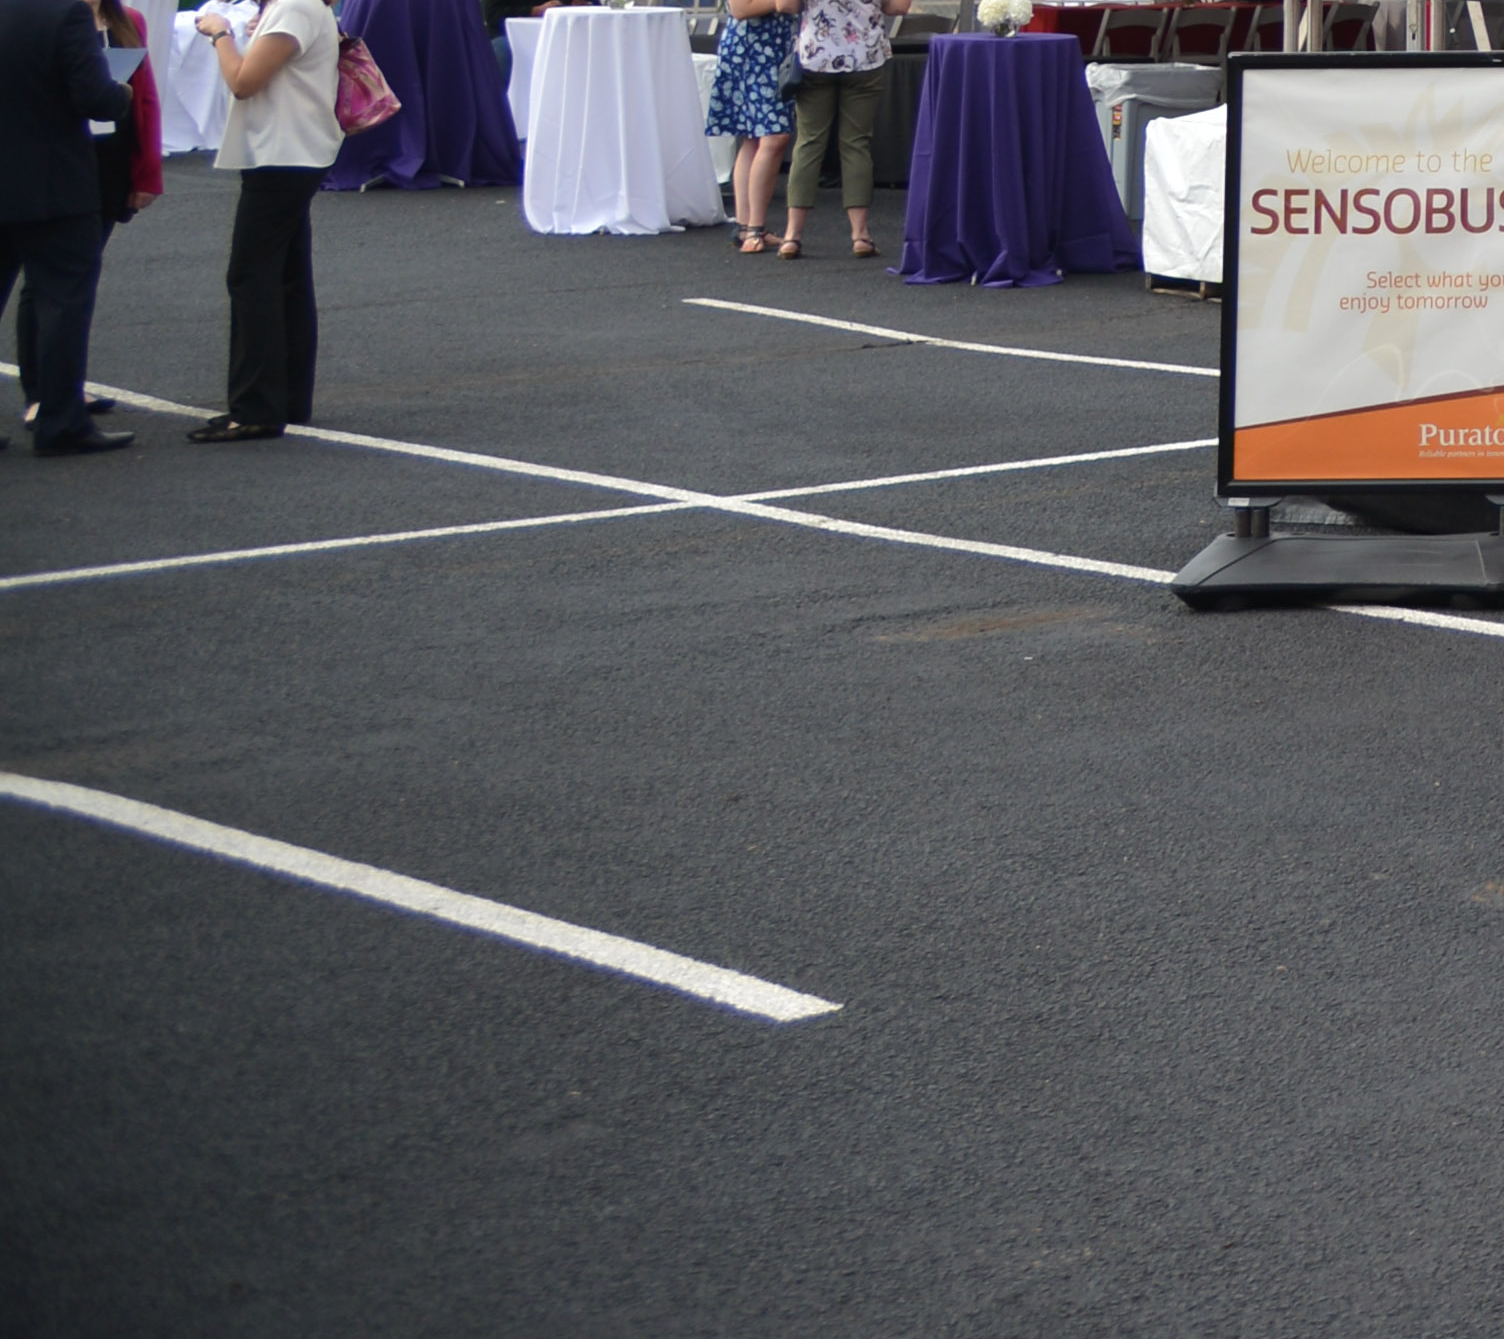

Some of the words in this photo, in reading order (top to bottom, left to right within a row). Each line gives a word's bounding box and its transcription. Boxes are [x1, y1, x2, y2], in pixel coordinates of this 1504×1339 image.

[1286, 149, 1406, 174] Welcome
[1417, 150, 1442, 173] to
[1451, 148, 1493, 173] the
[1366, 271, 1421, 289] Select
[1426, 270, 1472, 288] what
[1339, 293, 1390, 314] enjoy
[1397, 293, 1488, 310] tomorrow
